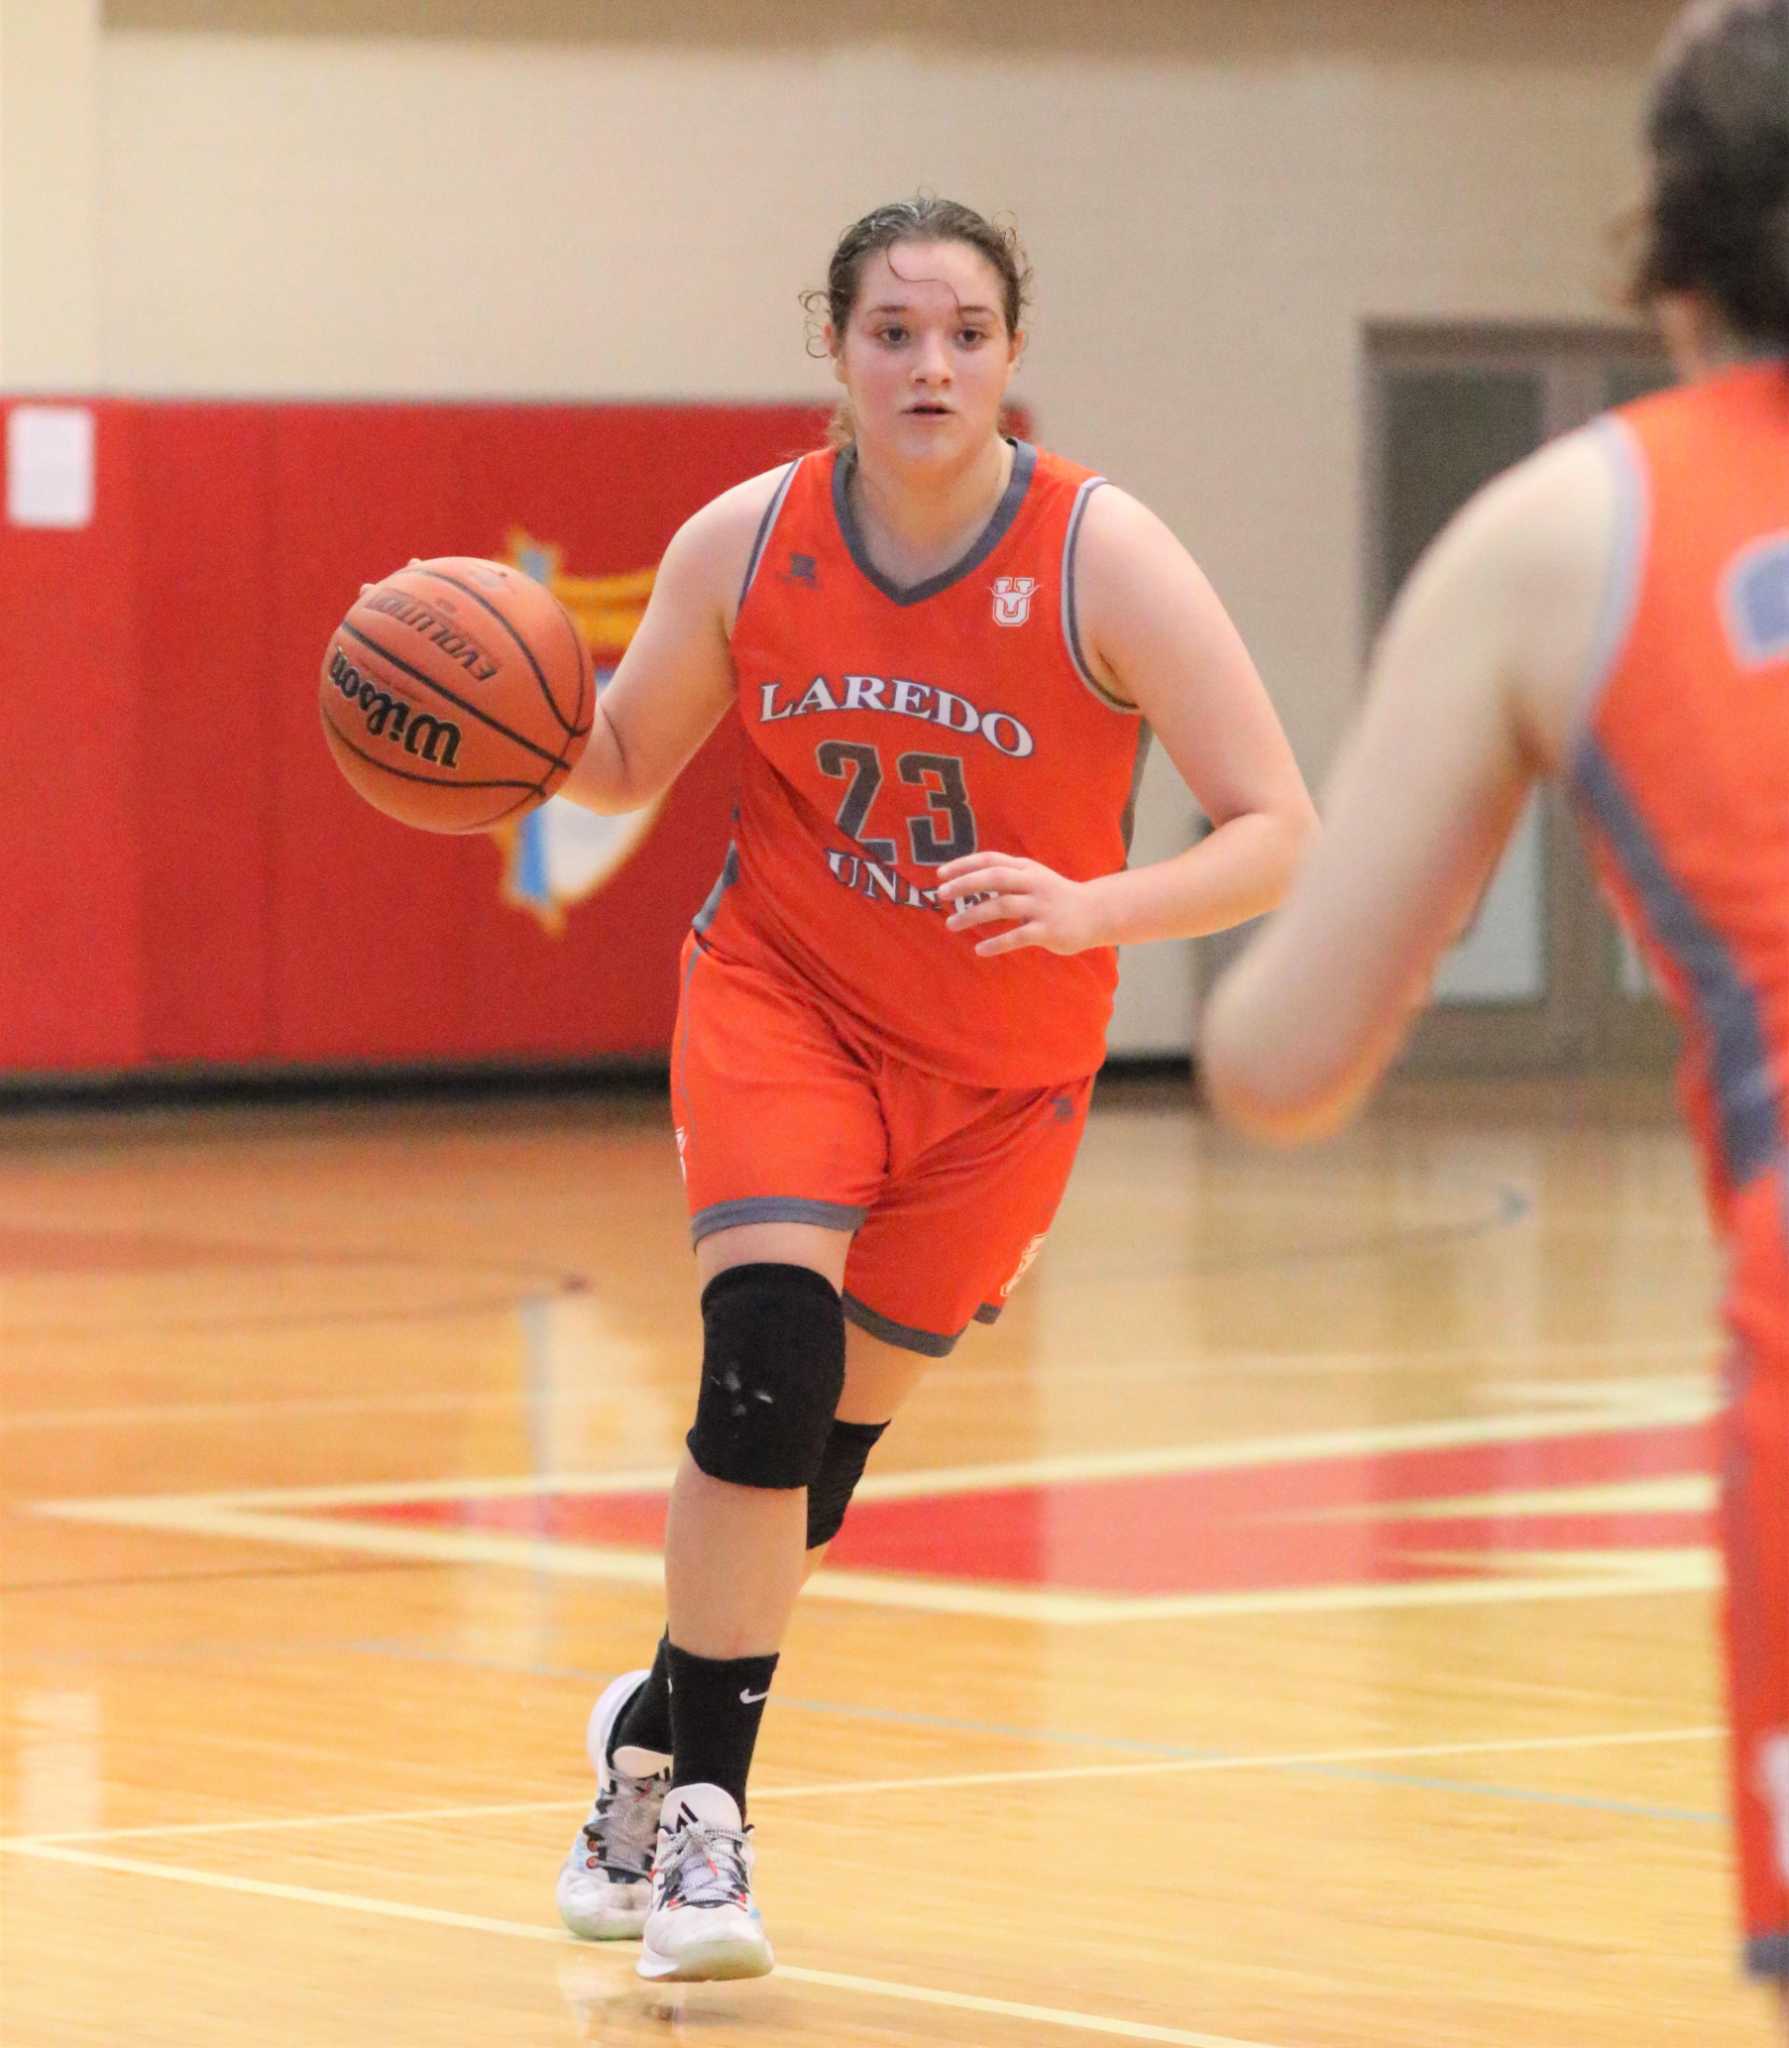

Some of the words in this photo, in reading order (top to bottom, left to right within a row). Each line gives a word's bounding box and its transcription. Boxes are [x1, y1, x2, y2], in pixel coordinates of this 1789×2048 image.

[330, 646, 461, 768] Wilson
[758, 674, 1036, 758] LAREDO
[816, 739, 977, 867] 23
[826, 848, 999, 915] UNI
